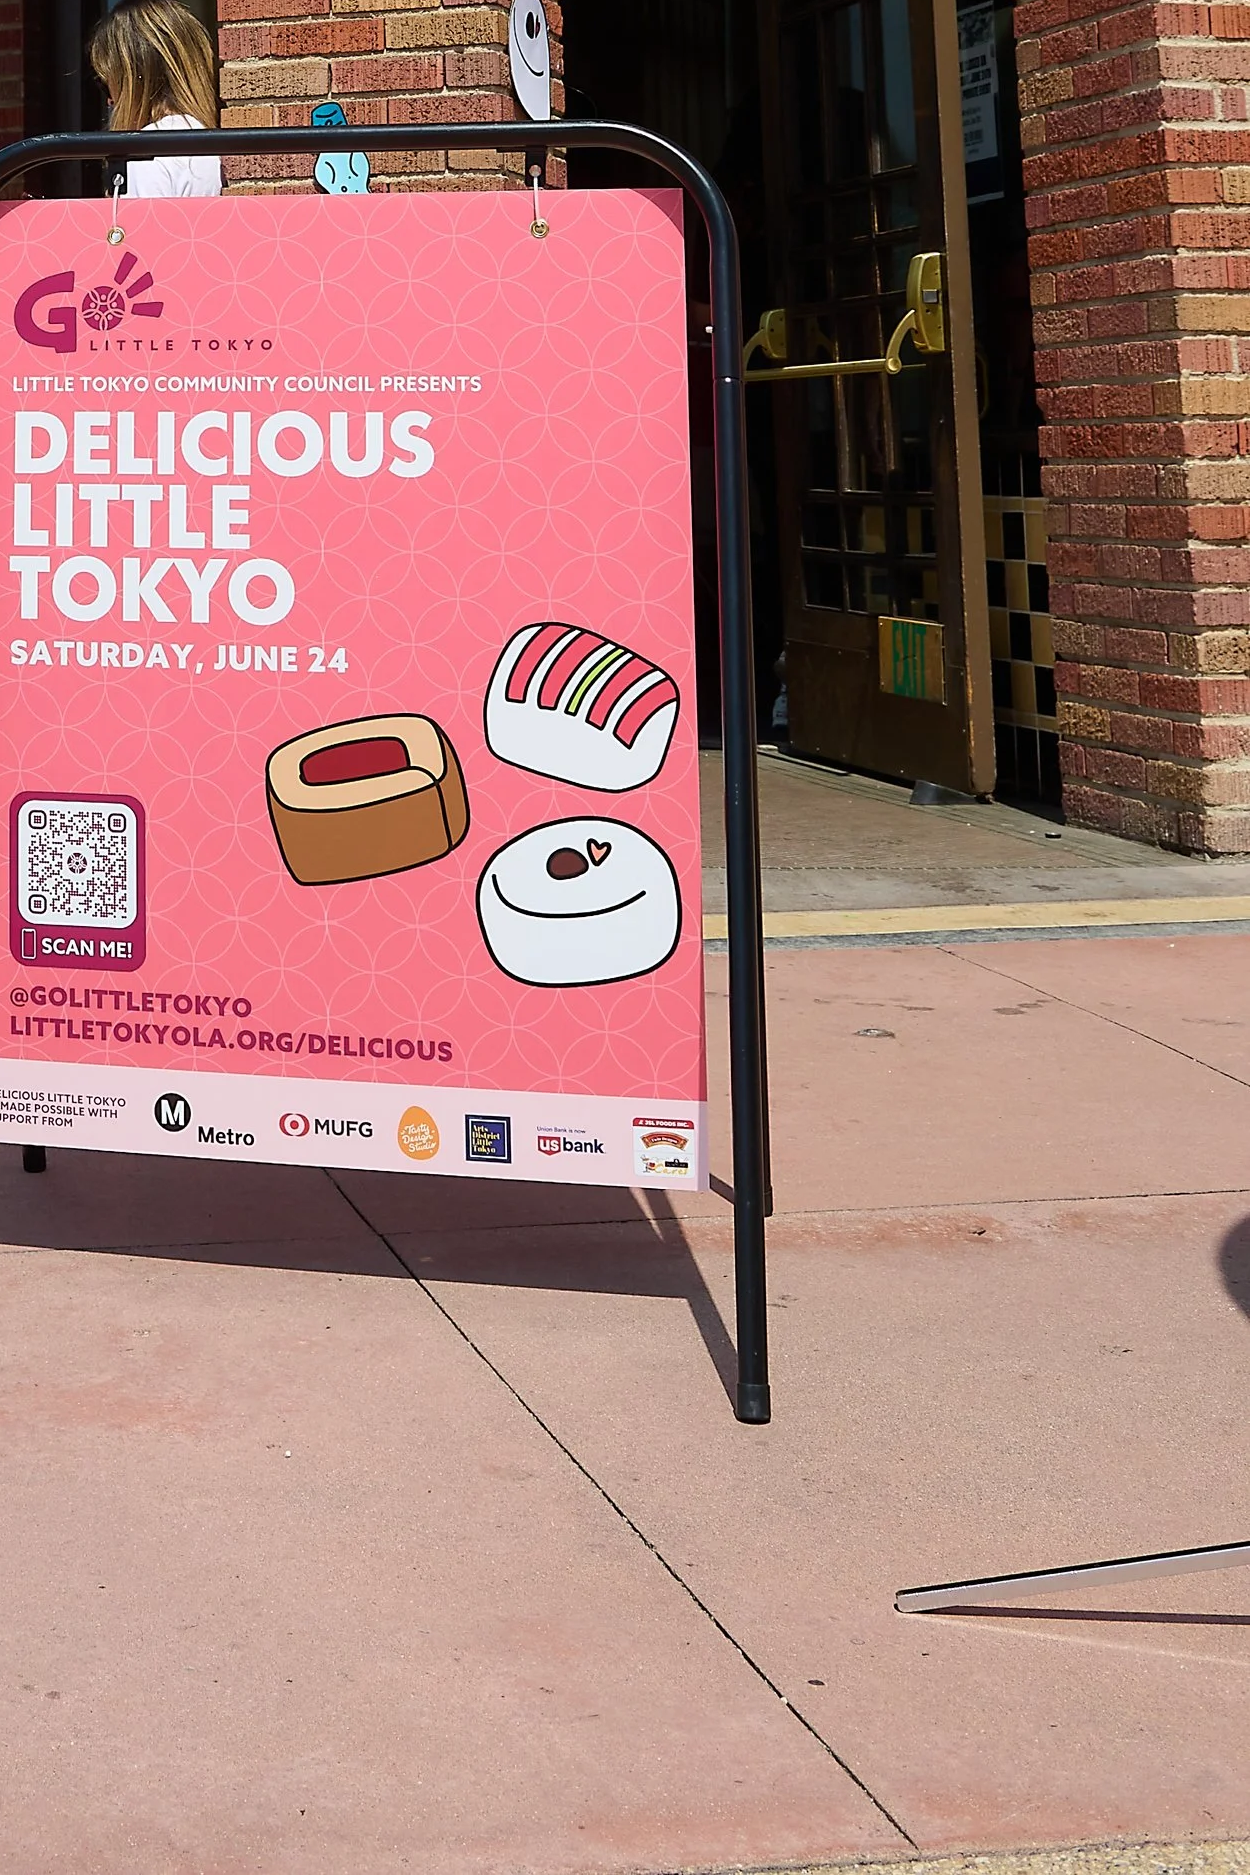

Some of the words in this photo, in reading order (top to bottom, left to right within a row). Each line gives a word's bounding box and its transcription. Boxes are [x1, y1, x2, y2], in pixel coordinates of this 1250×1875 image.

[90, 339, 174, 351] LITTLE
[192, 339, 274, 351] TOKYO
[12, 375, 75, 392] LITTLE
[79, 375, 149, 392] TOKYO
[154, 375, 277, 392] COMMUNITY
[283, 375, 375, 392] COUNCIL
[380, 375, 482, 393] PRESENTS
[13, 410, 436, 478] DELICIOUS
[12, 482, 251, 551] LITTLE
[9, 554, 296, 626] TOKYO
[9, 639, 205, 675] SATURDAY,
[213, 645, 299, 672] JUNE
[307, 646, 349, 674] 24
[892, 621, 926, 698] EXIT
[41, 937, 95, 958] SCAN
[98, 939, 133, 960] ME!
[9, 985, 252, 1018] @GOLITTLETOKYO
[9, 1015, 454, 1061] LITTLETOKYOLA.ORG/DELICIOUS
[47, 1092, 83, 1105] LITTLE
[86, 1095, 126, 1108] TOKYO
[0, 1101, 32, 1113] MADE
[34, 1104, 85, 1117] POSSIBLE
[87, 1108, 118, 1119] WITH
[161, 1099, 185, 1126] M
[41, 1116, 73, 1127] FROM
[314, 1118, 374, 1138] MUFG
[404, 1123, 431, 1136] Tasty
[472, 1124, 488, 1132] Arts
[198, 1126, 255, 1146] Metro
[401, 1133, 434, 1145] Design
[472, 1131, 501, 1140] District
[472, 1138, 493, 1146] Little
[408, 1141, 437, 1153] Studio
[472, 1145, 496, 1154] Tokyo
